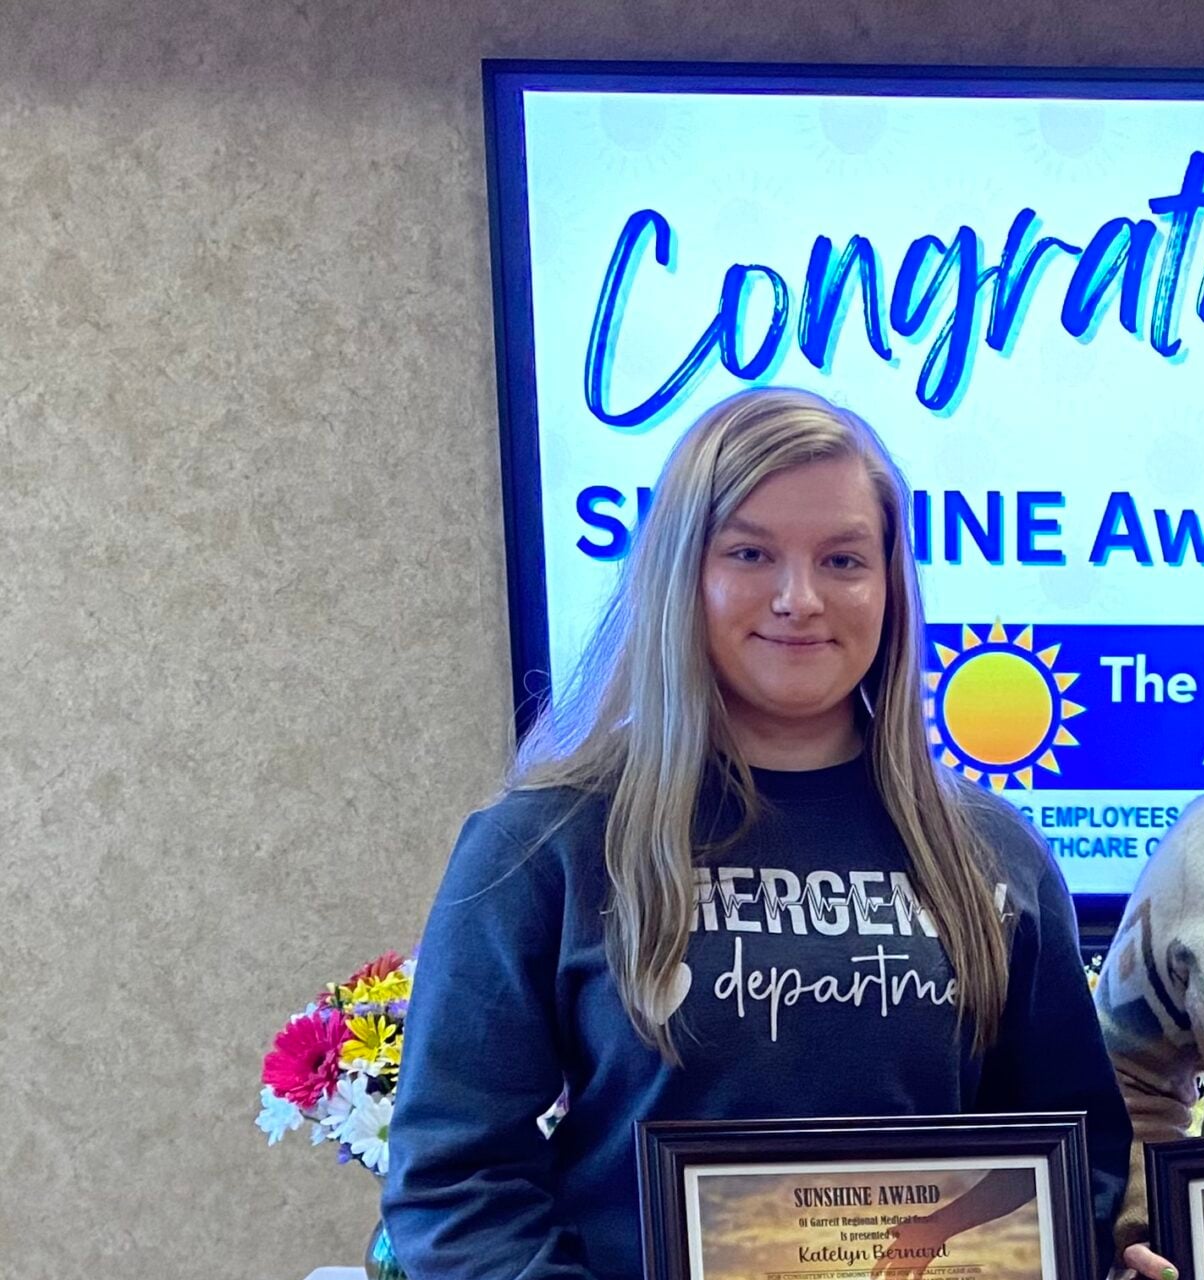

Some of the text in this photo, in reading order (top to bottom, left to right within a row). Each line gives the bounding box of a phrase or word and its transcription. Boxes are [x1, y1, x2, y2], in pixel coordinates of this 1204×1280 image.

[576, 485, 1066, 565] SINE
[1100, 655, 1198, 703] The
[1041, 806, 1179, 828] EMPLOYEES
[1046, 837, 1138, 858] THCARE
[714, 936, 957, 1041] departme
[794, 1184, 940, 1207] SUNSHINE AWARD
[799, 1243, 950, 1266] Katelyn Bernard
